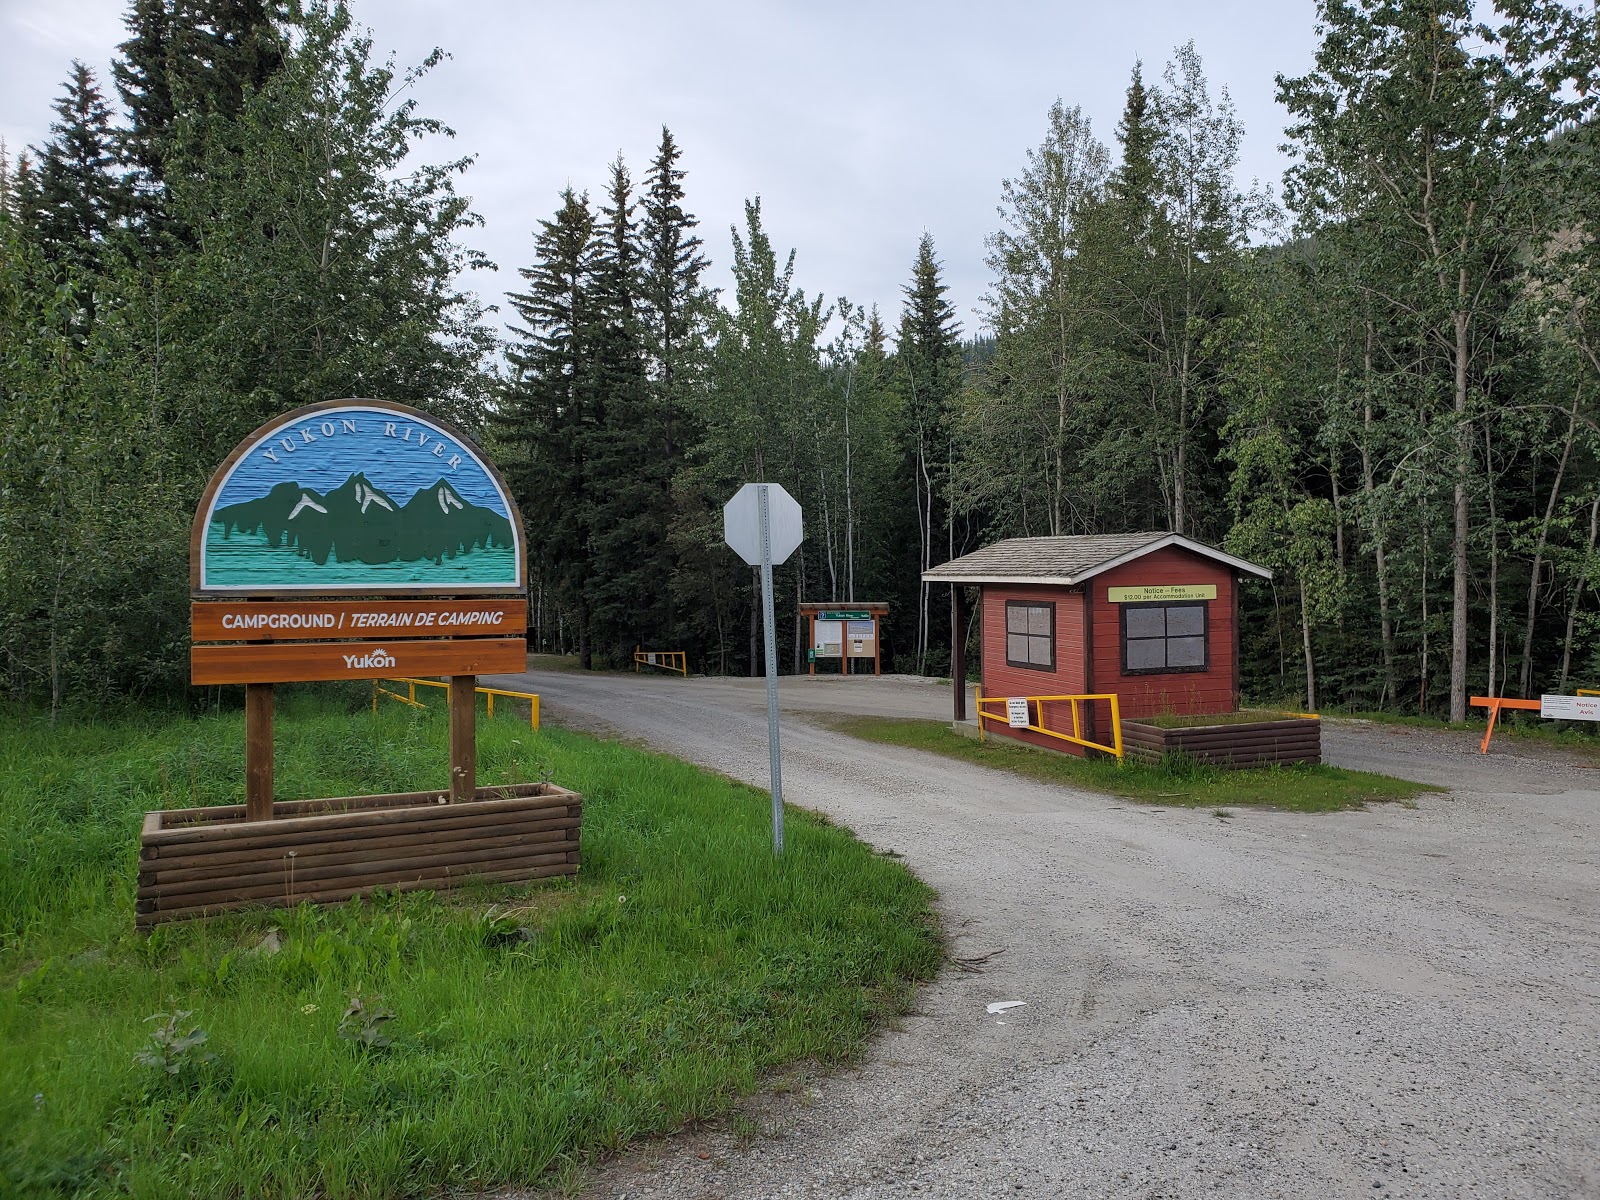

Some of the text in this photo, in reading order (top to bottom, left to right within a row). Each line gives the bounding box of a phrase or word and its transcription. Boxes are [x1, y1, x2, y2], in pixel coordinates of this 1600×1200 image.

[263, 419, 462, 470] YUKON RIVER
[222, 611, 503, 629] CAMPGROUND / TERRAIN DE CAMPING
[343, 652, 395, 668] Yukon
